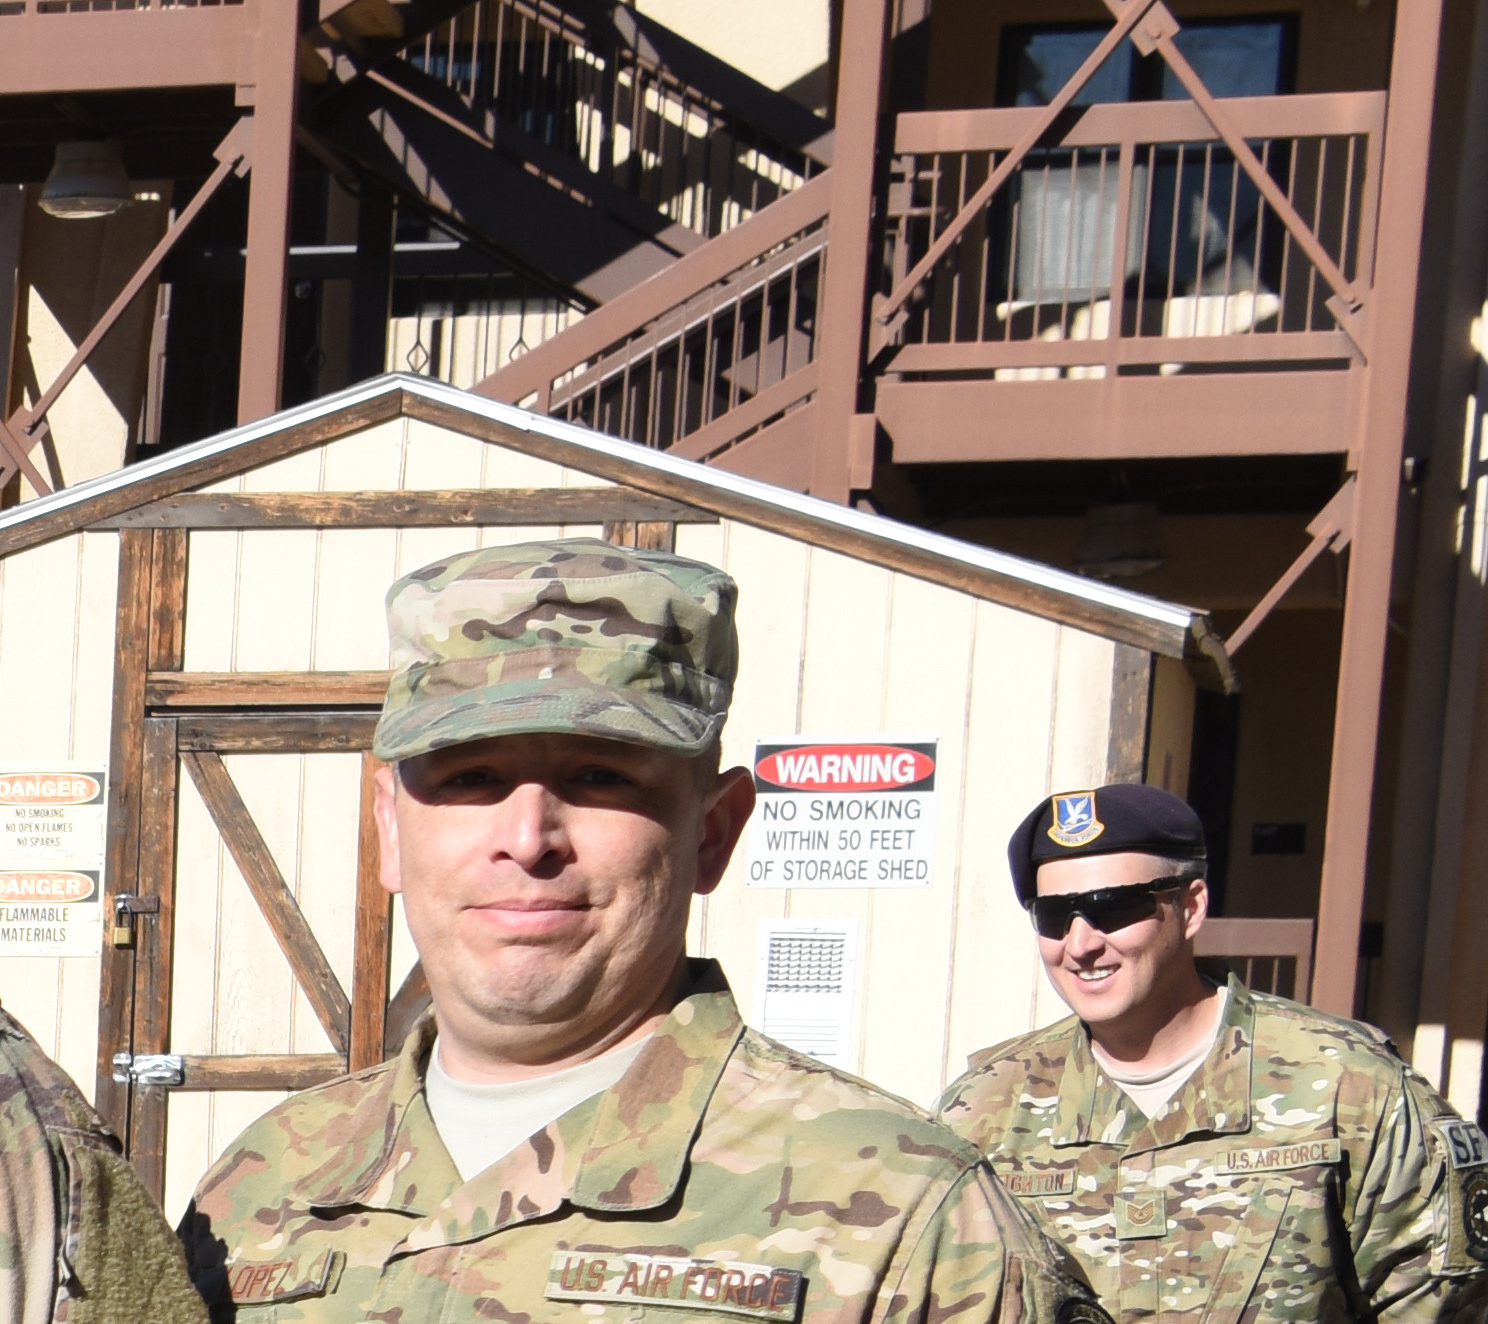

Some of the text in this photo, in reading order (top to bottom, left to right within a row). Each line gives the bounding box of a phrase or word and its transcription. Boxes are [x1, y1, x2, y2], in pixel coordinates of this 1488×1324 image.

[775, 753, 915, 784] WARNING
[15, 808, 65, 818] NO SMOKING
[763, 799, 921, 821] NO SMOKING
[6, 822, 73, 833] NO OPEN FLAMES
[17, 837, 61, 847] NO SPARKS
[766, 829, 916, 851] WITHIN 50 FEET
[750, 859, 928, 881] OF STORAGE SHED
[0, 907, 69, 922] FLAMMABLE
[0, 927, 66, 942] MATERIALS
[1448, 1123, 1482, 1164] SF
[1227, 1143, 1329, 1170] U.S. AIR FORCE
[616, 1261, 674, 1299] AIR
[680, 1266, 791, 1313] FORCE
